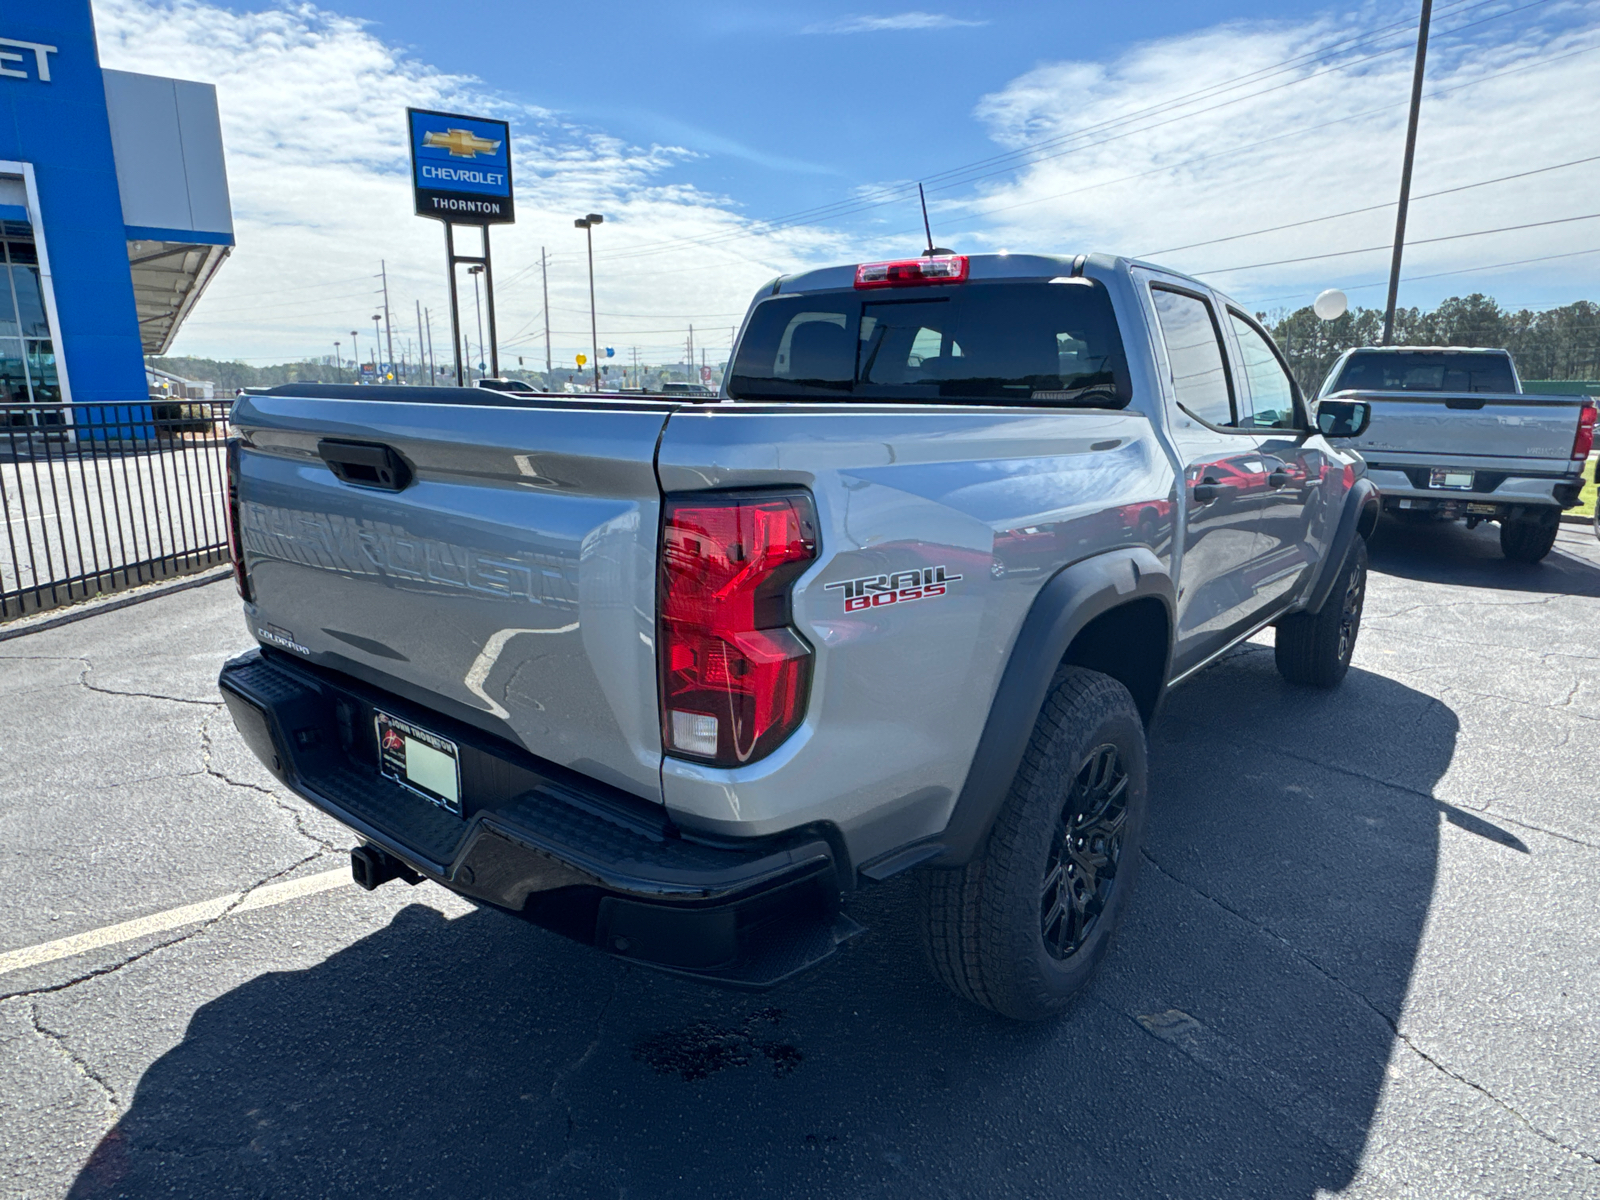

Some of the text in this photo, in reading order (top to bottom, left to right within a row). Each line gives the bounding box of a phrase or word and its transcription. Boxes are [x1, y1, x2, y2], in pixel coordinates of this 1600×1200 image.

[422, 165, 504, 186] CHEVROLET
[432, 197, 501, 214] THORNTON
[824, 565, 963, 599] TRAIL
[844, 583, 947, 614] BOSS
[258, 627, 311, 655] COLORADO
[391, 718, 411, 734] JOHN
[410, 727, 453, 754] THORNTON
